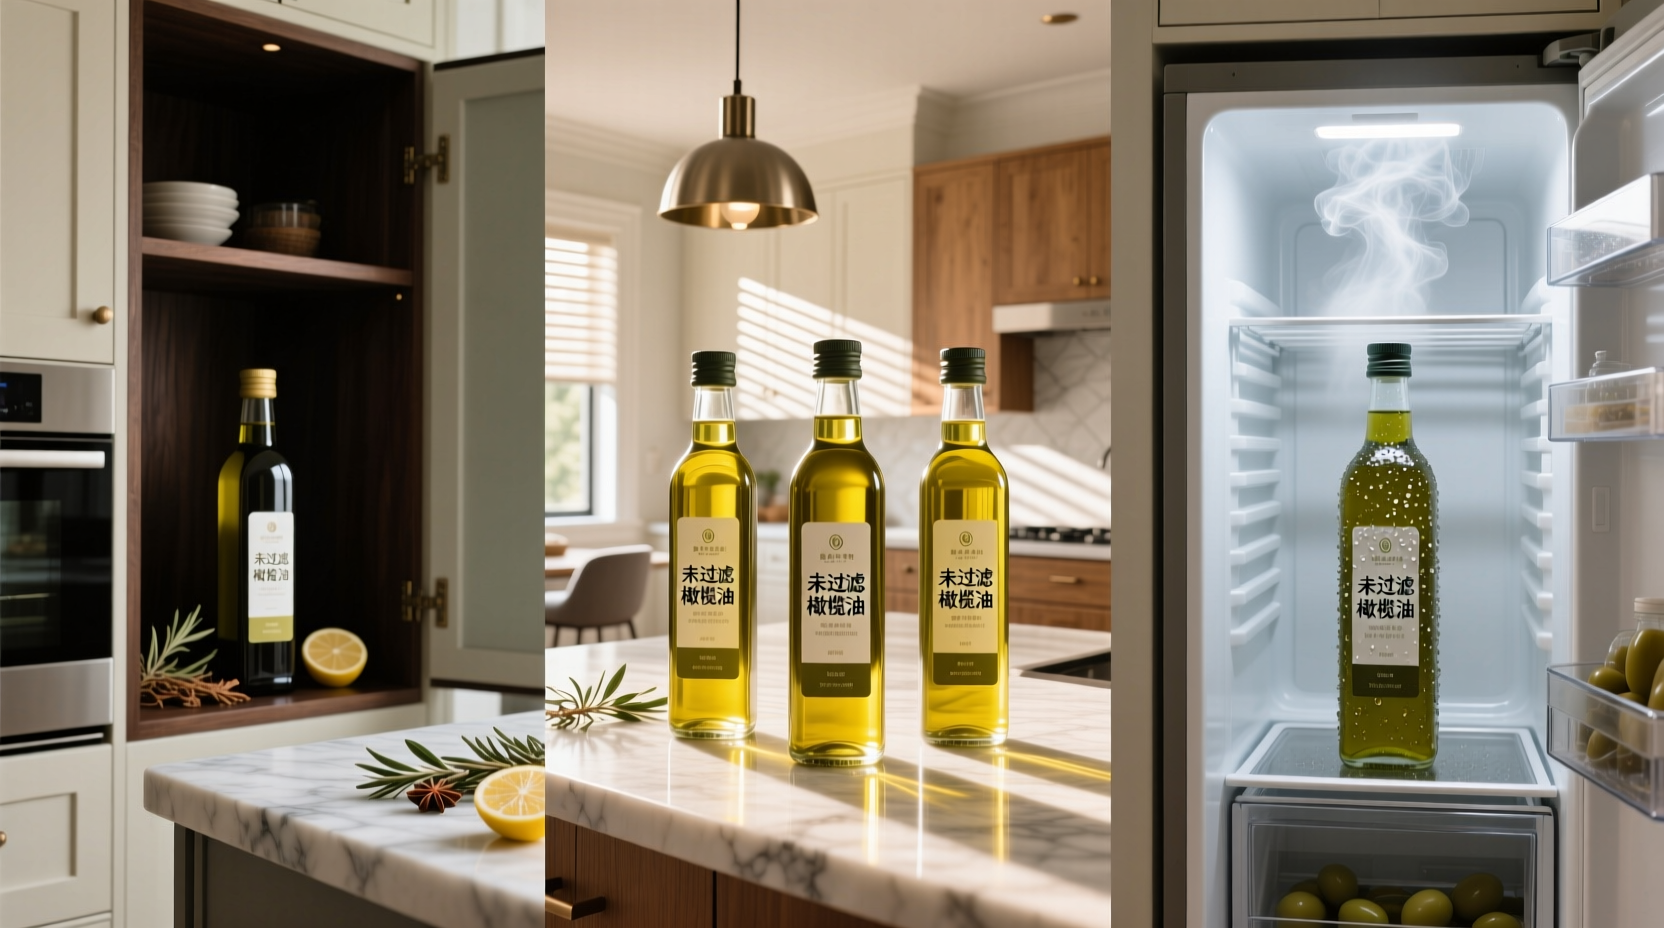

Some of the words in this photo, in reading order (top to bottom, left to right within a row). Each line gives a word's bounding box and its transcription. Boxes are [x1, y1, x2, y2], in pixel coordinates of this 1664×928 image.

[807, 572, 865, 593] 未过滤
[938, 567, 993, 588] 未过滤
[1358, 575, 1414, 595] 未过滤
[681, 585, 734, 606] 橄榄油
[807, 595, 865, 616] 橄榄油
[938, 589, 993, 609] 橄榄油
[1357, 598, 1414, 619] 橄榄油
